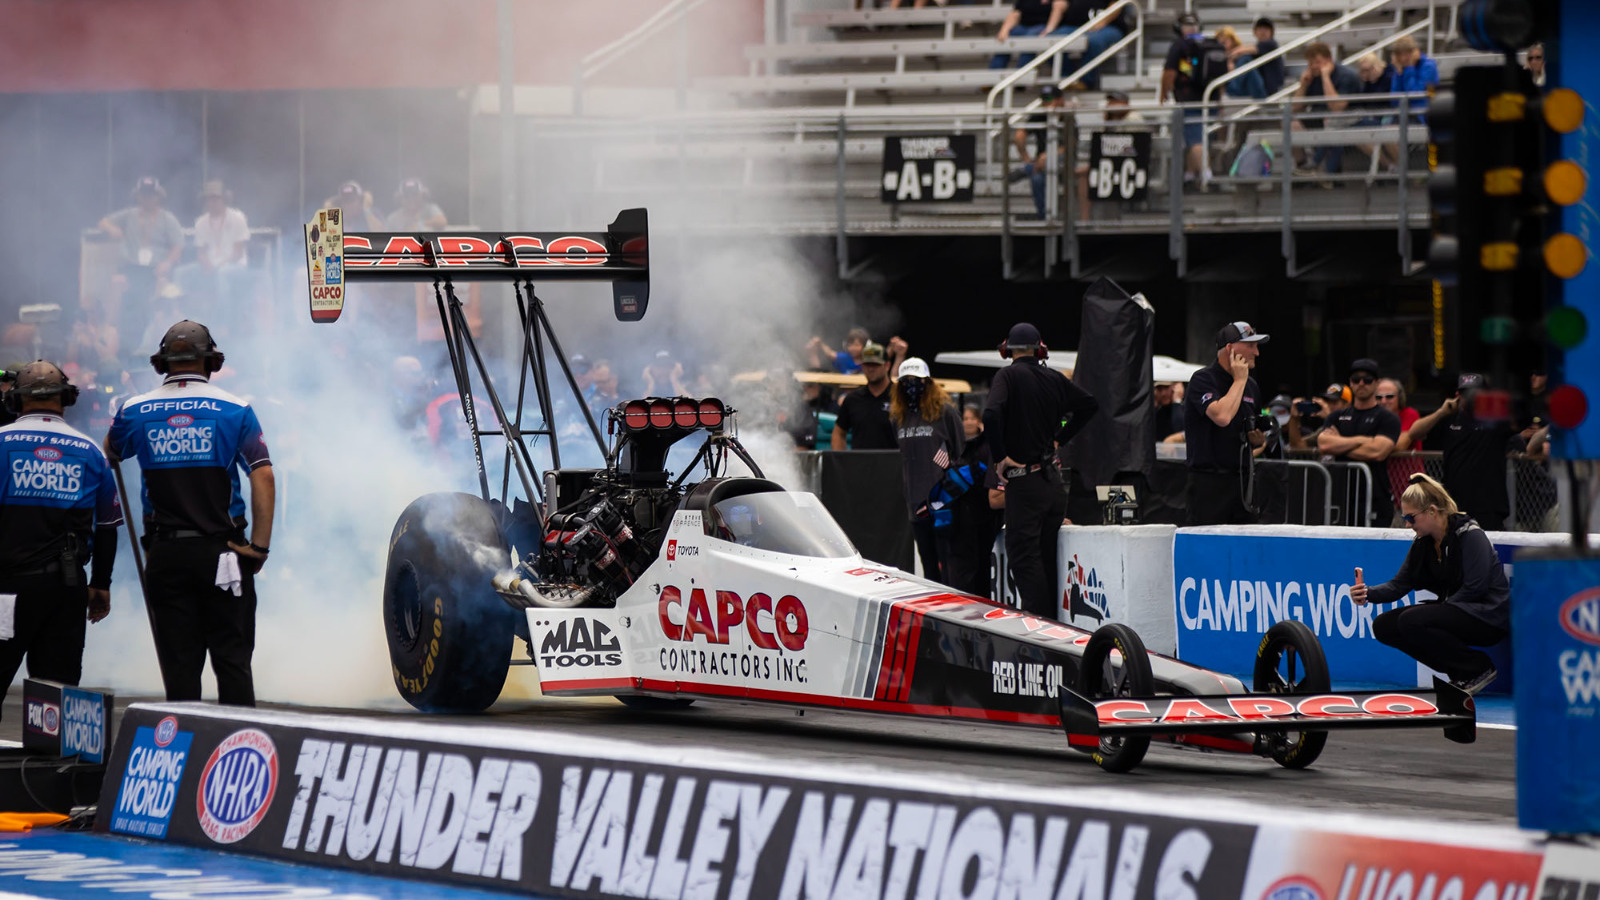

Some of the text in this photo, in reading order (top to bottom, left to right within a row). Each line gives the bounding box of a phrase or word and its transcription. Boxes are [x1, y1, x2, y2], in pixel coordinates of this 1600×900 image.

[344, 236, 607, 265] CAPCO
[312, 286, 342, 299] CAPCO
[140, 400, 222, 413] OFFICIAL
[4, 434, 91, 450] SAFETY SAFARI
[147, 427, 213, 442] CAMPING
[150, 439, 212, 455] WORLD
[12, 459, 81, 478] CAMPING
[37, 451, 59, 459] NHRA
[13, 473, 80, 492] WORLD
[677, 546, 699, 556] TOYOTA
[658, 585, 809, 651] CAPCO
[1179, 577, 1304, 633] CAMPING
[540, 617, 621, 654] MAC
[541, 653, 622, 668] TOOLS
[660, 647, 808, 683] CONTRACTORS INC.
[992, 660, 1016, 695] RED
[1018, 662, 1047, 697] LINE
[28, 703, 42, 728] FOX
[64, 696, 101, 727] CAMPING
[1096, 693, 1439, 723] CAPCO
[64, 719, 101, 754] WORLD
[221, 732, 273, 755] CHAMPIONSHIP
[128, 746, 185, 782] CAMPING
[120, 777, 175, 818] WORLD
[207, 751, 267, 821] NHRA
[201, 812, 219, 839] DRAG
[281, 738, 542, 882] THUNDER
[550, 765, 791, 900] VALLEY
[775, 791, 1213, 900] NATIONALS
